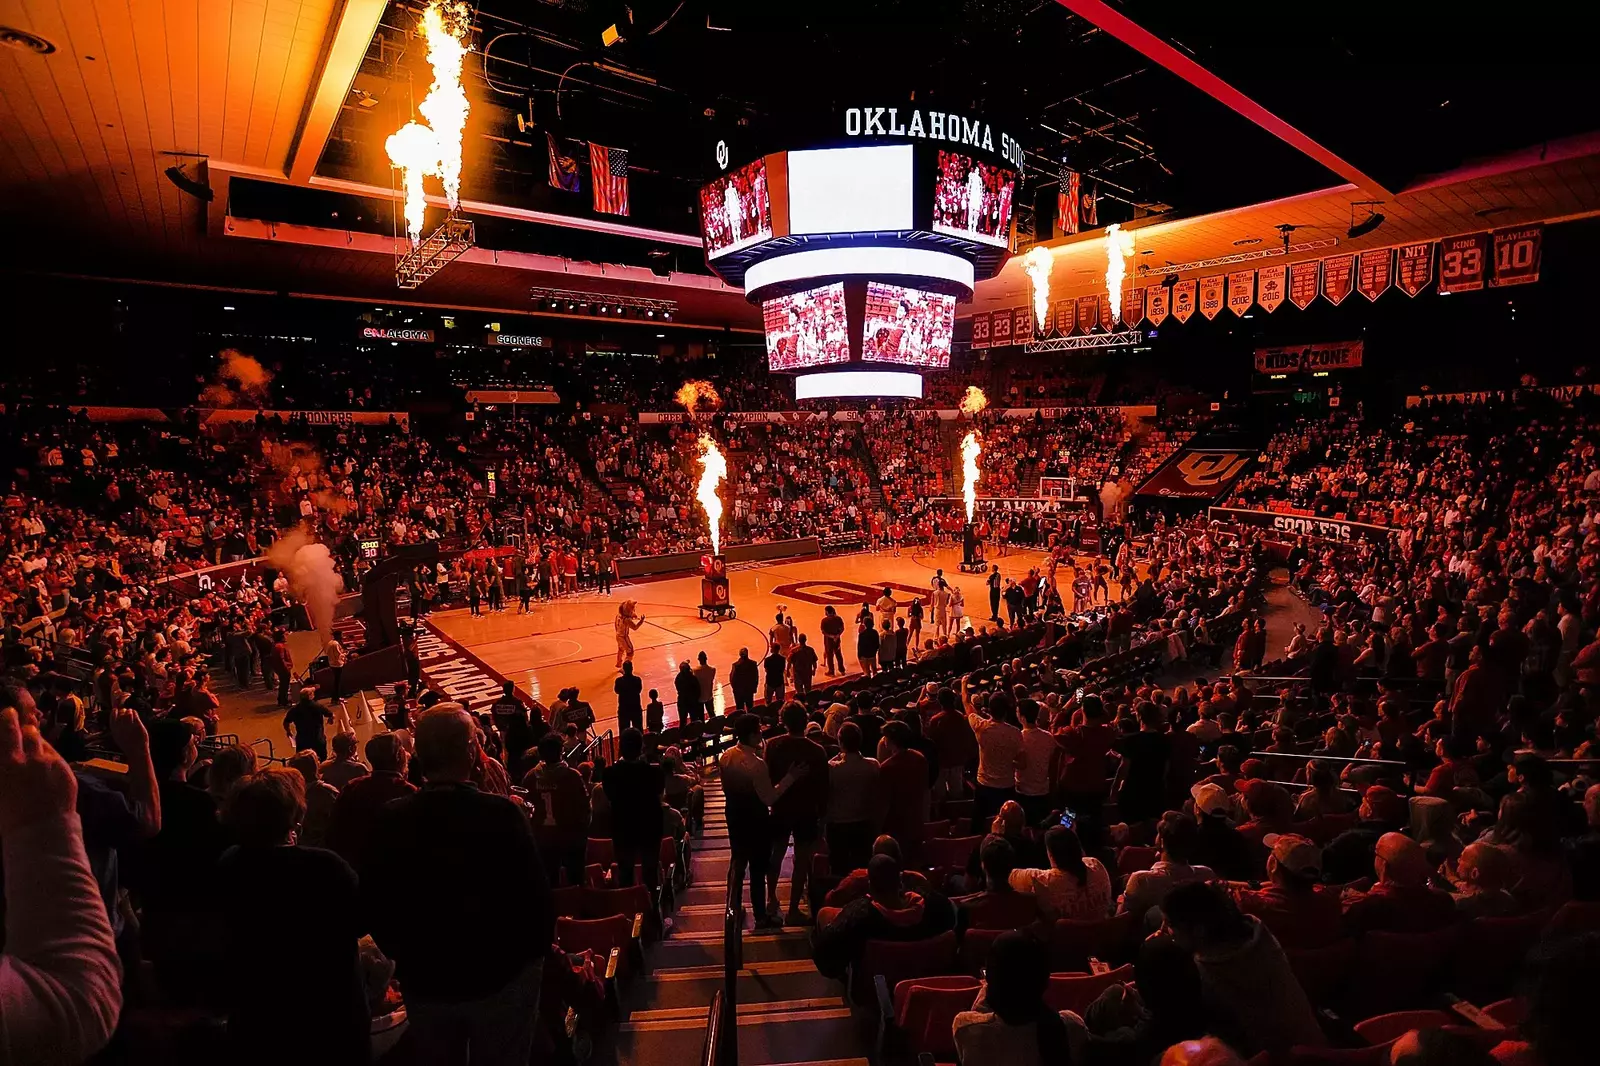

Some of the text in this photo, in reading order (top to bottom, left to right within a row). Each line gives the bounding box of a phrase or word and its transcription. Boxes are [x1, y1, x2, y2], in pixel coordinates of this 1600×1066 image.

[846, 107, 996, 156] OKLAHOMA
[1453, 239, 1475, 250] KING
[1405, 245, 1428, 258] NIT
[1499, 240, 1534, 270] 10
[1444, 248, 1482, 278] 33
[1232, 296, 1249, 305] 2002
[1262, 292, 1280, 301] 2016
[1176, 304, 1191, 313] 1947
[1203, 300, 1218, 309] 1988
[1151, 307, 1164, 316] 1939
[974, 321, 990, 339] 33
[994, 319, 1011, 337] 23
[1015, 316, 1032, 335] 23
[364, 328, 430, 340] OKLAHOMA
[497, 335, 543, 346] SOONERS
[1311, 348, 1348, 366] ZONE
[361, 541, 379, 549] 20:00
[364, 548, 377, 557] 30
